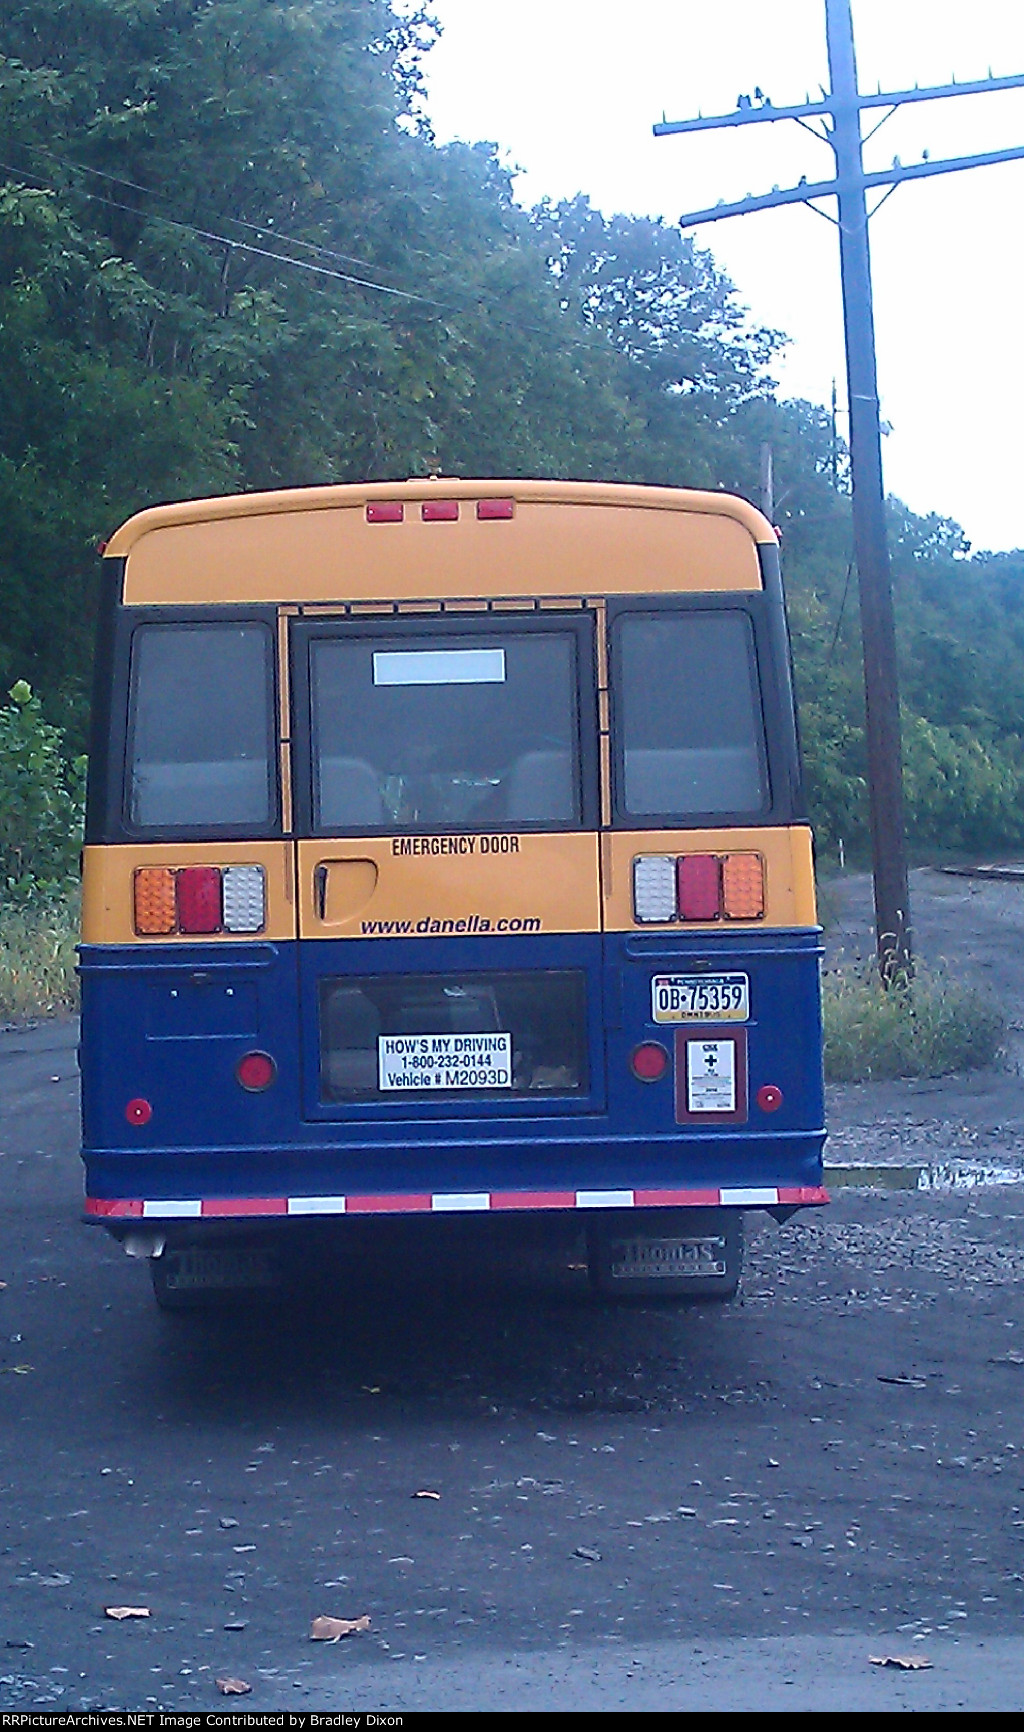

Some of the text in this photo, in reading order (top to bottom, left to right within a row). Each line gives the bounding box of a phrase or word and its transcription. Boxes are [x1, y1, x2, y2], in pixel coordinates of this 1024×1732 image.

[391, 836, 520, 856] EMERGENCY DOOR
[361, 915, 542, 934] www.danella.com
[385, 1037, 507, 1054] HOW'S MY DRIVING
[401, 1053, 493, 1069] 1-800-232-0144
[388, 1069, 509, 1087] Vehicle # M2093D
